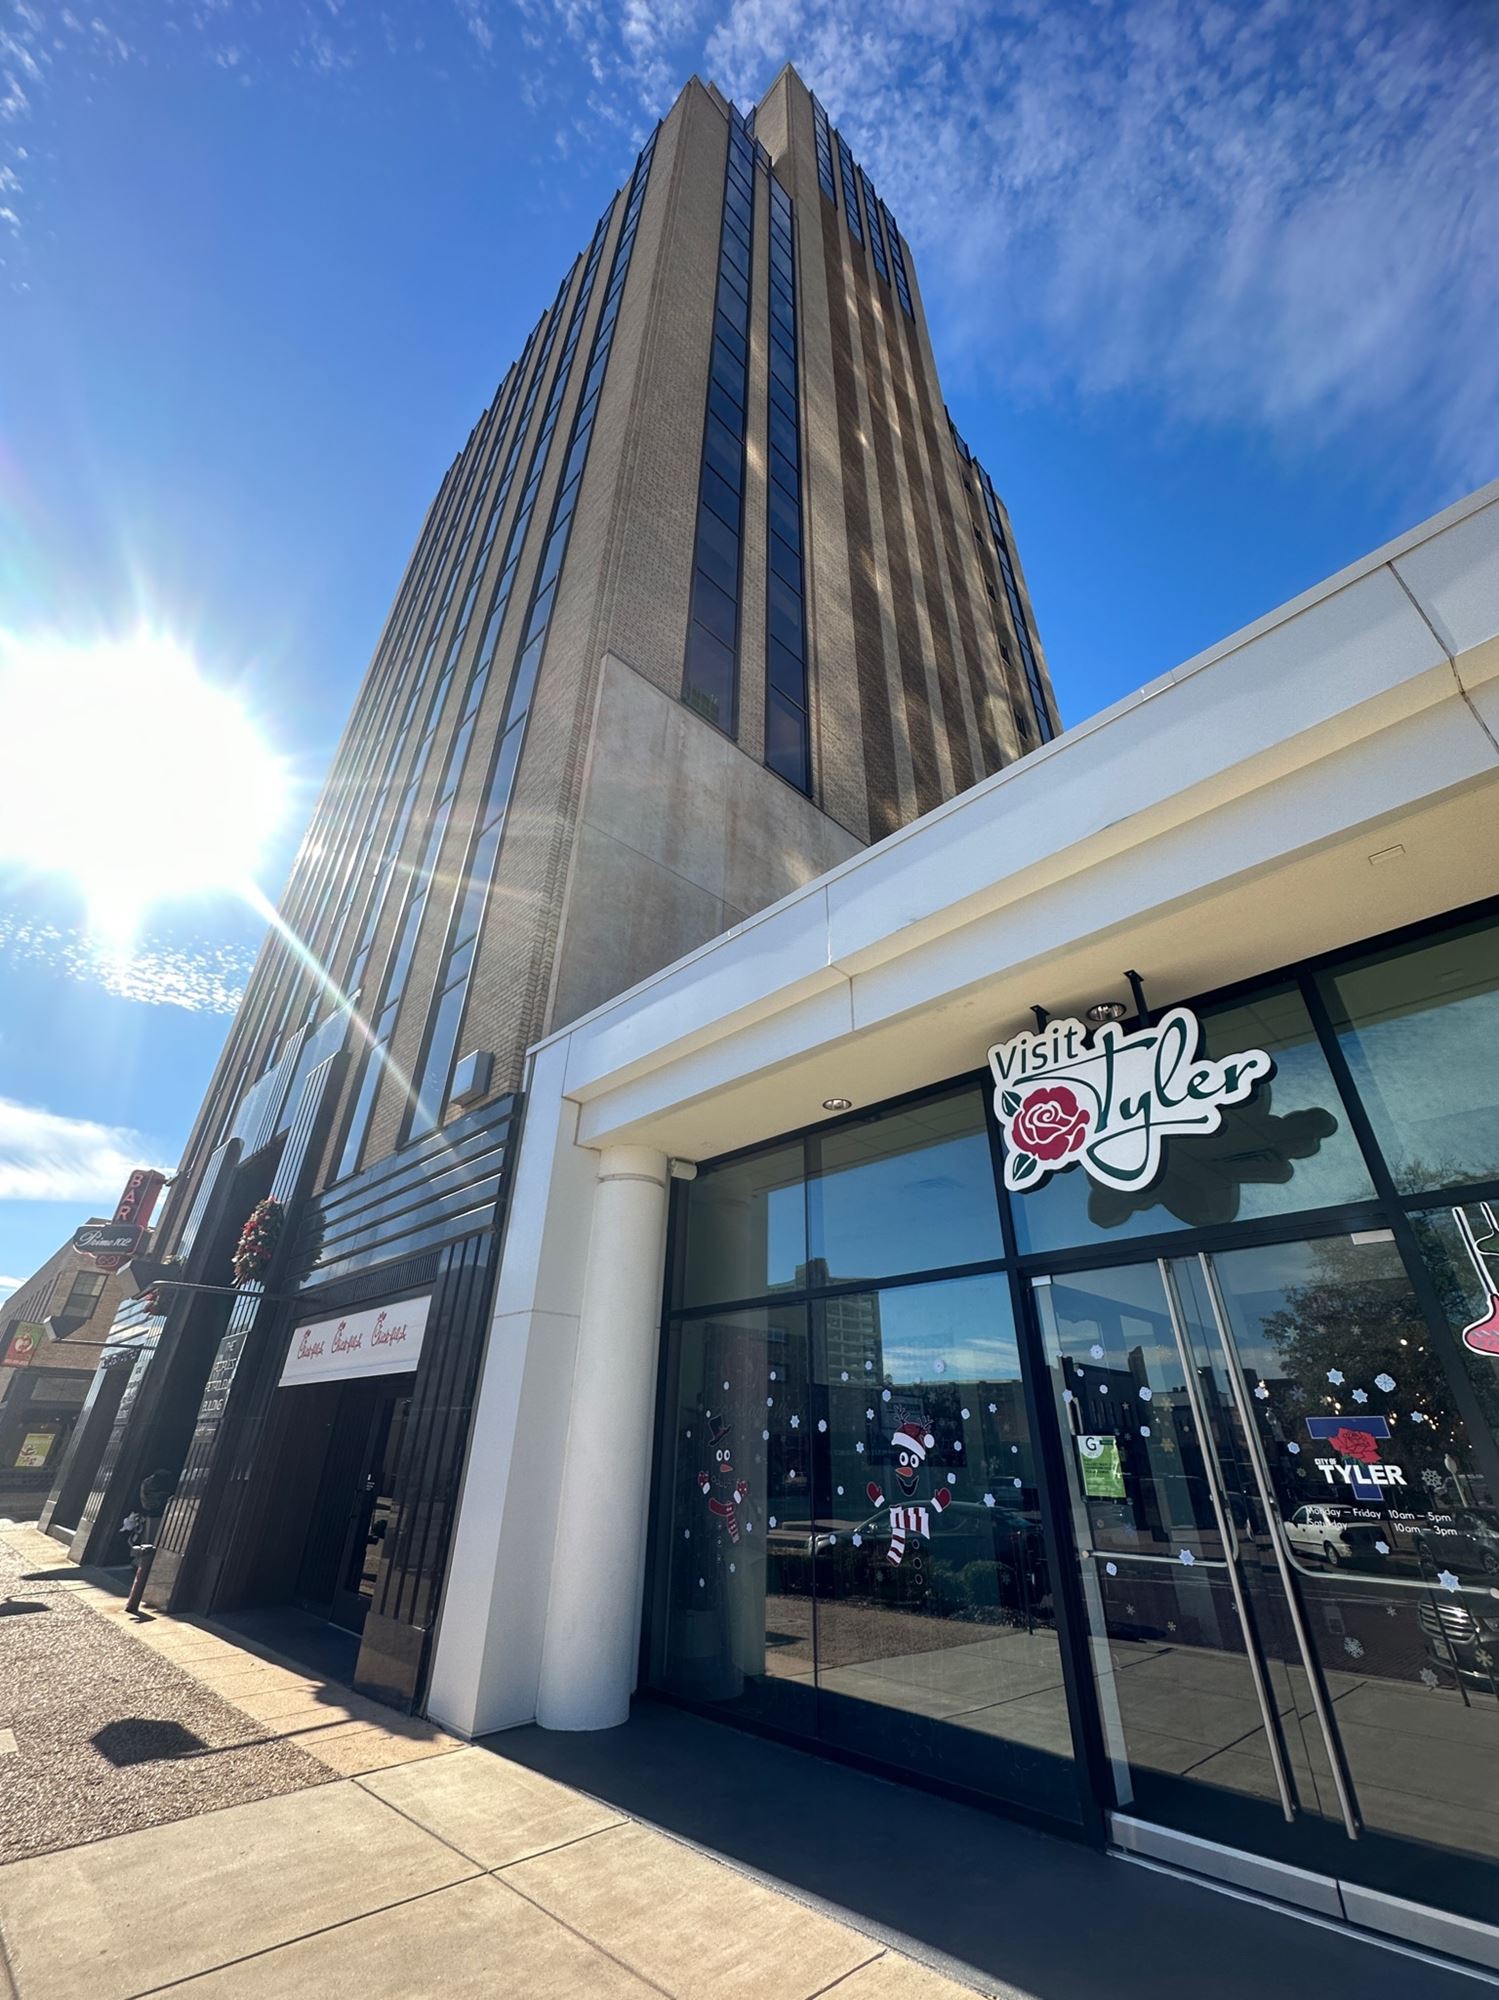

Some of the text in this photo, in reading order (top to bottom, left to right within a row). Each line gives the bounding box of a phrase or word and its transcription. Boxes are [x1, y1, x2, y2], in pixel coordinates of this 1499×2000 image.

[995, 1024, 1079, 1081] Visit
[1012, 1016, 1258, 1182] Tyler
[118, 1174, 143, 1221] BAR
[76, 1230, 133, 1247] Prime 102
[1318, 1465, 1407, 1485] TYLER
[1352, 1508, 1382, 1519] Friday
[1388, 1509, 1415, 1520] 10am
[1428, 1511, 1452, 1523] 5pm
[1308, 1519, 1348, 1530] Satuday
[1393, 1522, 1421, 1533] 10am
[1434, 1526, 1458, 1537] 3pm
